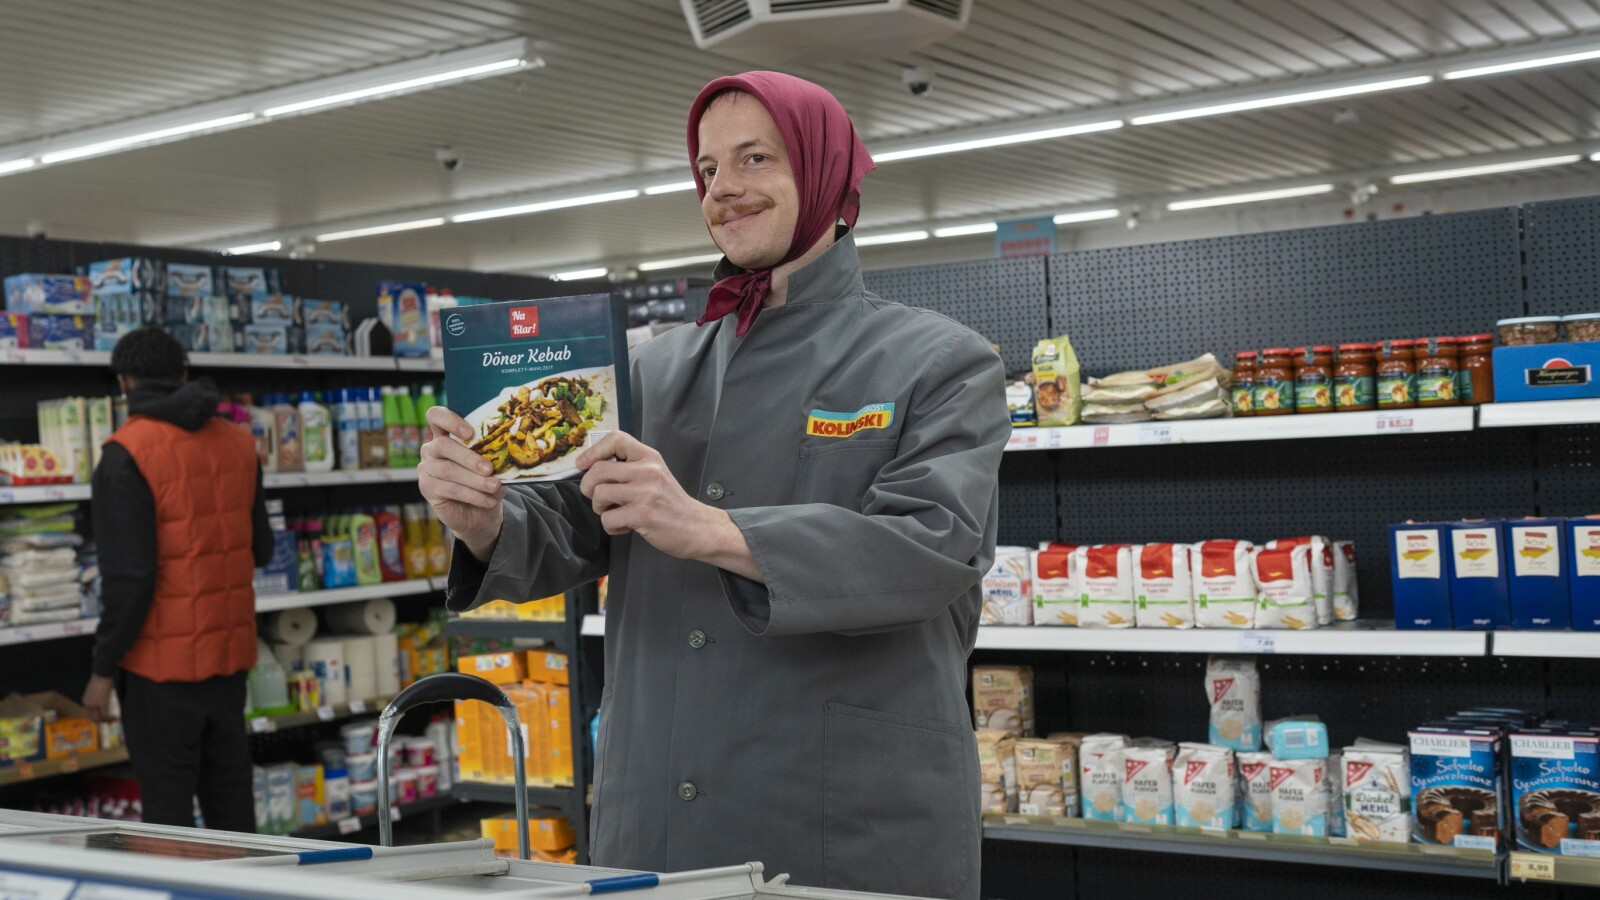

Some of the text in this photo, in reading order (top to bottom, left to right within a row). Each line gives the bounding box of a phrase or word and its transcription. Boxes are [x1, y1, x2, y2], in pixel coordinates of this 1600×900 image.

[512, 310, 526, 321] Na
[512, 323, 536, 335] Klar!
[482, 345, 571, 367] Döner Kebab
[501, 365, 553, 374] KOMPLETT-MAHLZEIT
[812, 413, 883, 435] KOLINSKI
[1413, 737, 1468, 748] CHARLIER
[1513, 739, 1571, 750] CHARLIER
[1435, 758, 1484, 774] Schoko
[1538, 760, 1590, 777] Schoko
[1356, 792, 1395, 805] Dinkel
[1361, 804, 1389, 813] MEHL
